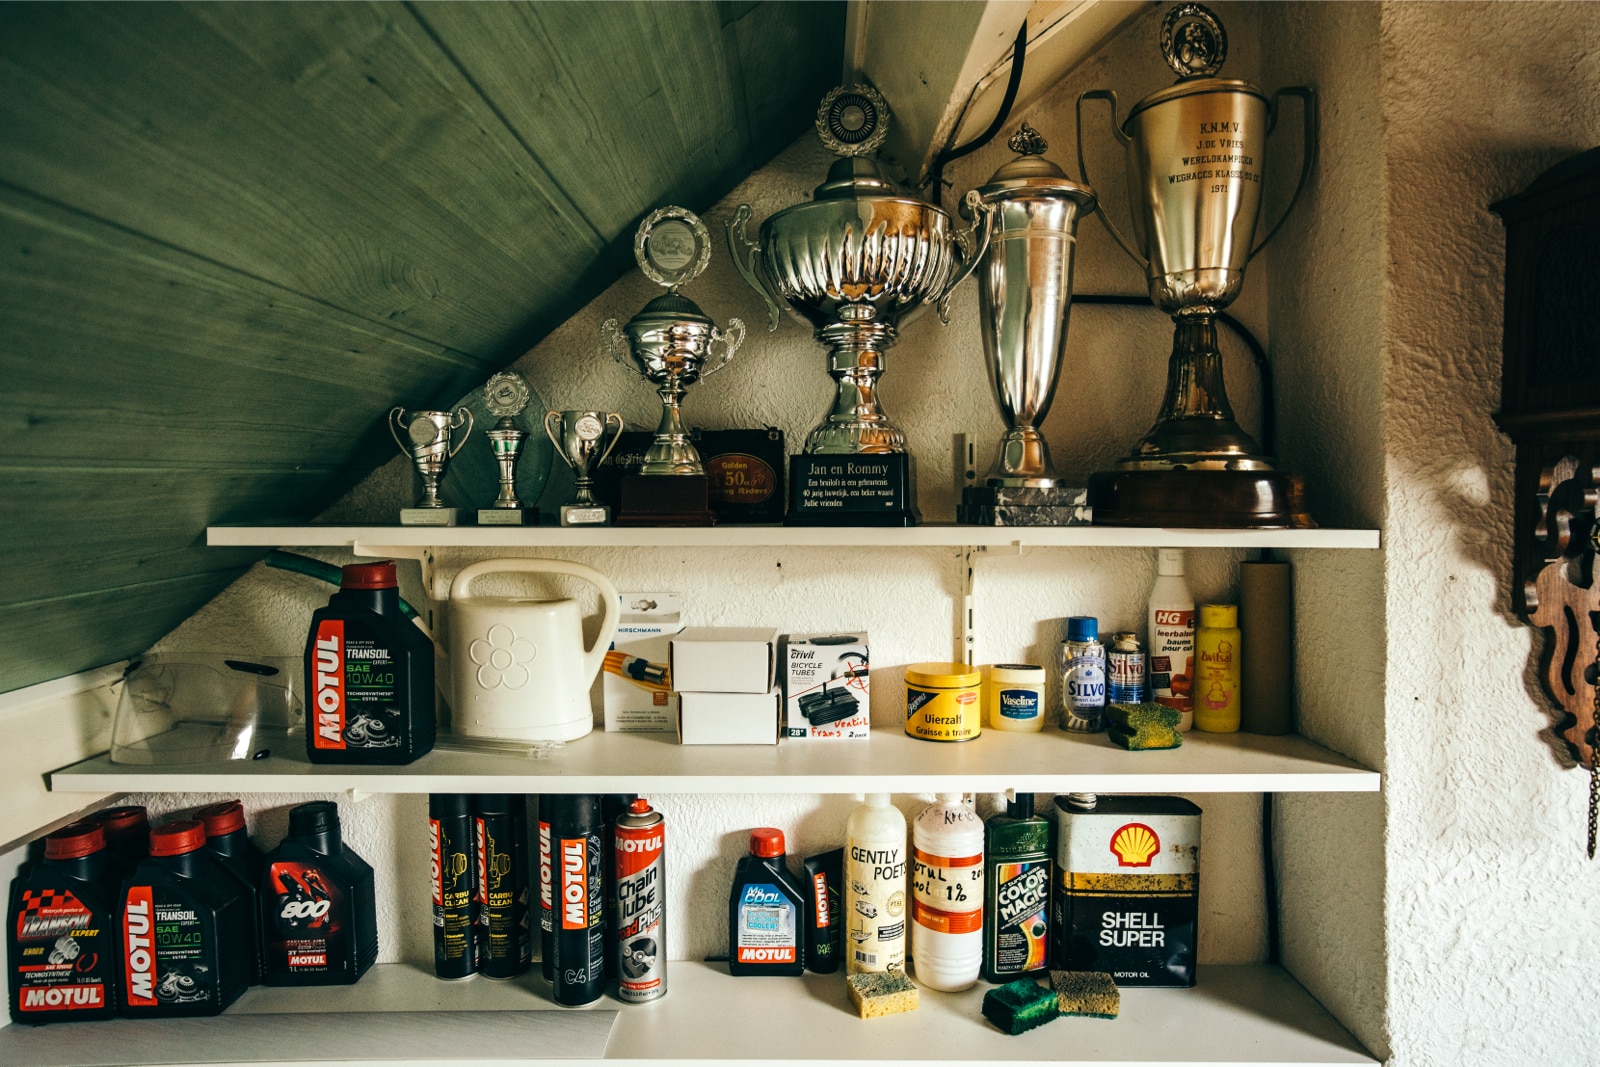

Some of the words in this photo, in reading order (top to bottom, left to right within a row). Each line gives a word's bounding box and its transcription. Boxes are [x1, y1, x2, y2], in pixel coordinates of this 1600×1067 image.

[1220, 139, 1244, 149] VRIES
[1168, 170, 1213, 184] WEGRACES
[1215, 170, 1243, 179] KLASSE
[1211, 185, 1228, 193] 1971
[808, 463, 826, 475] Jan
[847, 462, 888, 476] Rommy
[725, 471, 744, 486] 50
[858, 479, 888, 487] gebeurtenis
[738, 487, 767, 495] Riders
[811, 489, 823, 498] jarig
[819, 499, 843, 507] vrienden
[1156, 612, 1181, 624] HG
[346, 649, 391, 659] TRANSOIL
[1201, 650, 1232, 662] Zwitsal
[346, 664, 370, 672] SAE
[1108, 658, 1144, 675] Silvo
[317, 635, 341, 742] MOTUL
[1068, 680, 1104, 697] SILVO
[1002, 694, 1036, 706] Vaseline
[924, 713, 963, 725] Uierzalf
[916, 727, 943, 737] Graisse
[945, 727, 950, 736] à
[952, 728, 971, 736] traire
[615, 835, 663, 853] MOTUL
[429, 823, 441, 901] MOTUL
[476, 822, 486, 900] MOTUL
[851, 846, 899, 865] GENTLY
[540, 825, 553, 907] MOTUL
[564, 842, 585, 924] MOTUL
[618, 866, 657, 900] Chain
[998, 868, 1049, 905] COLOR
[444, 891, 470, 900] CARBU
[489, 891, 513, 900] CARBU
[489, 898, 513, 906] CLEAN
[744, 893, 782, 903] COOL
[816, 876, 828, 923] MOTUL
[1000, 884, 1048, 921] MAGIC
[280, 900, 331, 918] 800
[622, 887, 655, 920] lube
[155, 911, 197, 921] TRANSOIL
[1101, 911, 1165, 929] SHELL
[21, 914, 91, 937] TRANSOIL
[1099, 929, 1165, 948] SUPER
[127, 900, 153, 1000] MOTUL
[741, 948, 792, 960] MOTUL
[290, 955, 325, 965] MOTUL
[564, 968, 587, 985] C4
[25, 987, 101, 1007] MOTUL
